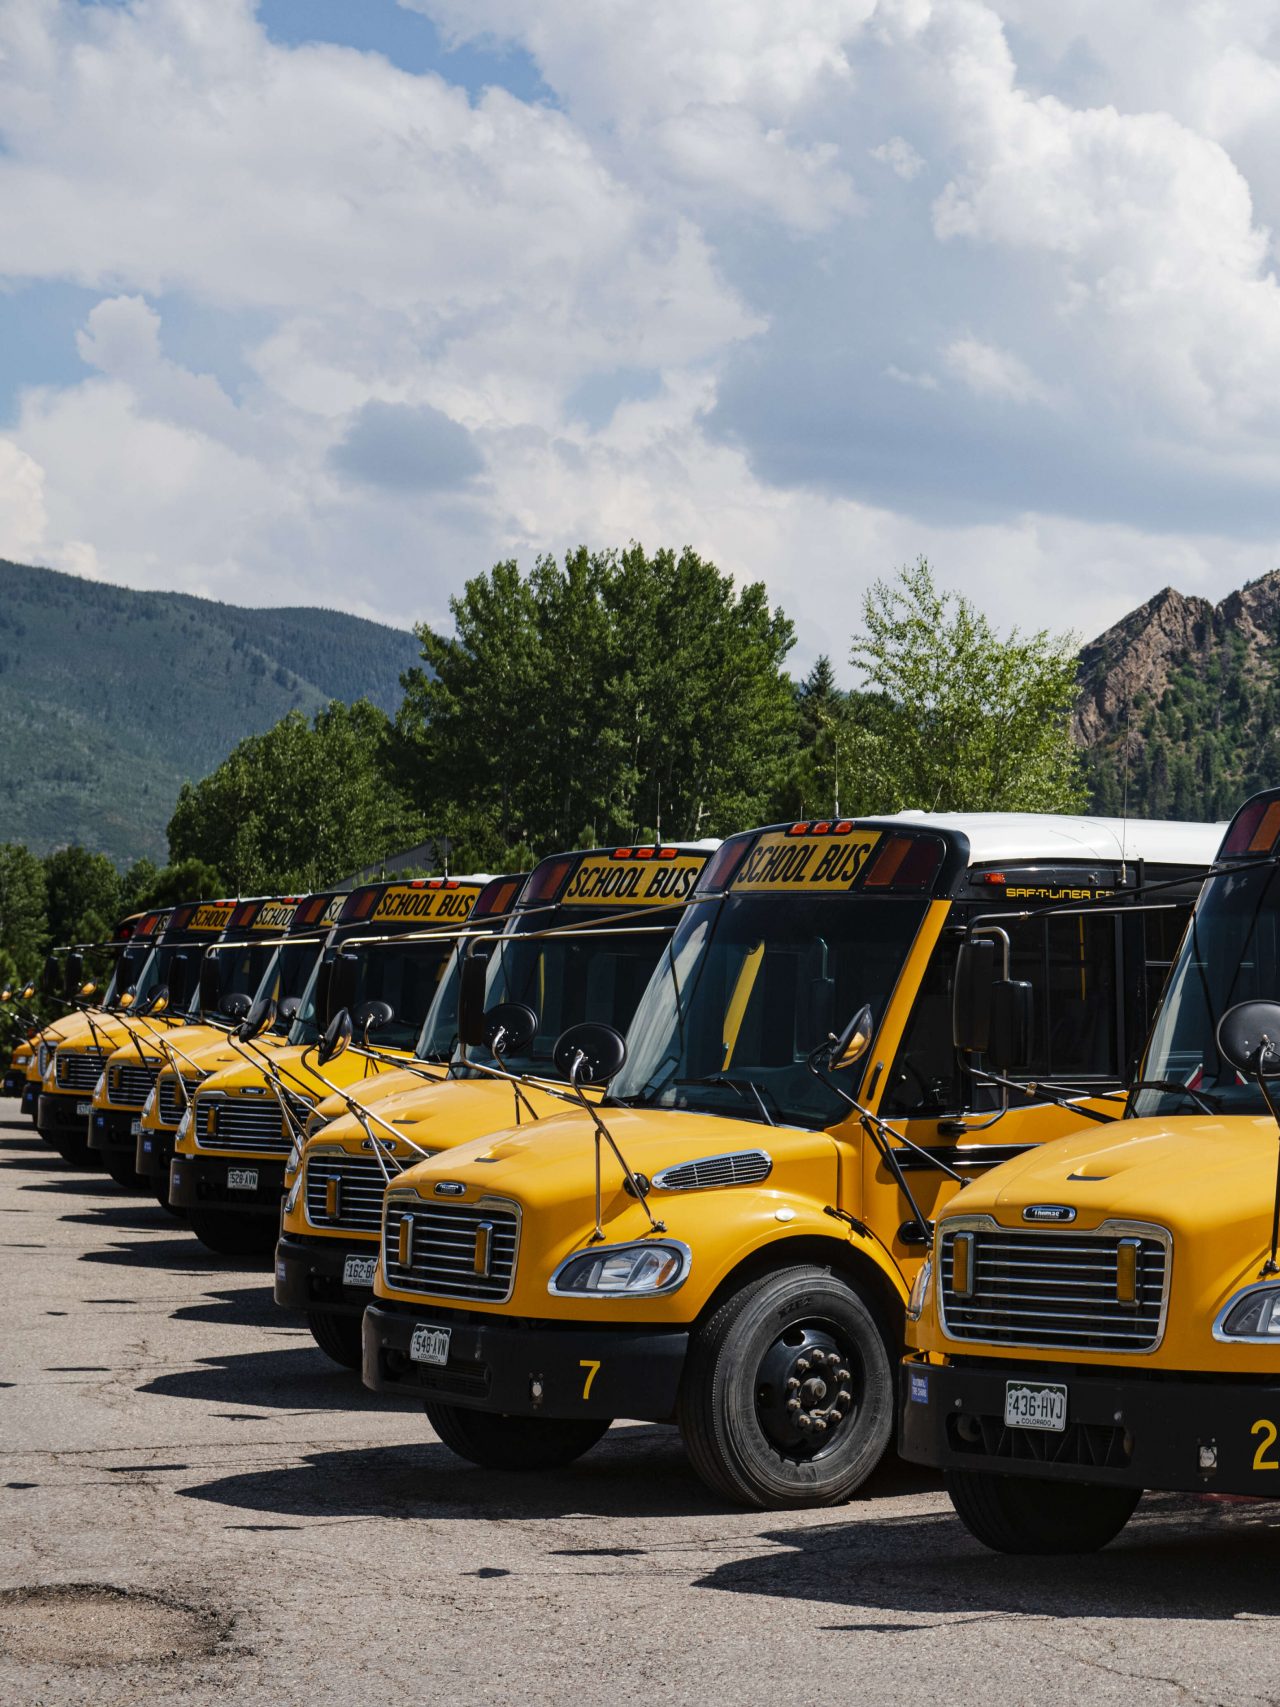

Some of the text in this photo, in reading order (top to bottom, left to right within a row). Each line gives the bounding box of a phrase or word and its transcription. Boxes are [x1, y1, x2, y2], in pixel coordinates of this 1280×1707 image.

[737, 843, 872, 883] SCHOOL BUS
[567, 866, 699, 898] SCHOOL BUS
[1006, 888, 1091, 899] SAF-T-LINER
[376, 893, 476, 916] SCHOOL BUS
[190, 910, 230, 927] SCHOOL
[255, 907, 296, 926] SCHOO
[580, 1360, 601, 1399] 7
[1021, 1417, 1052, 1427] COLORADO
